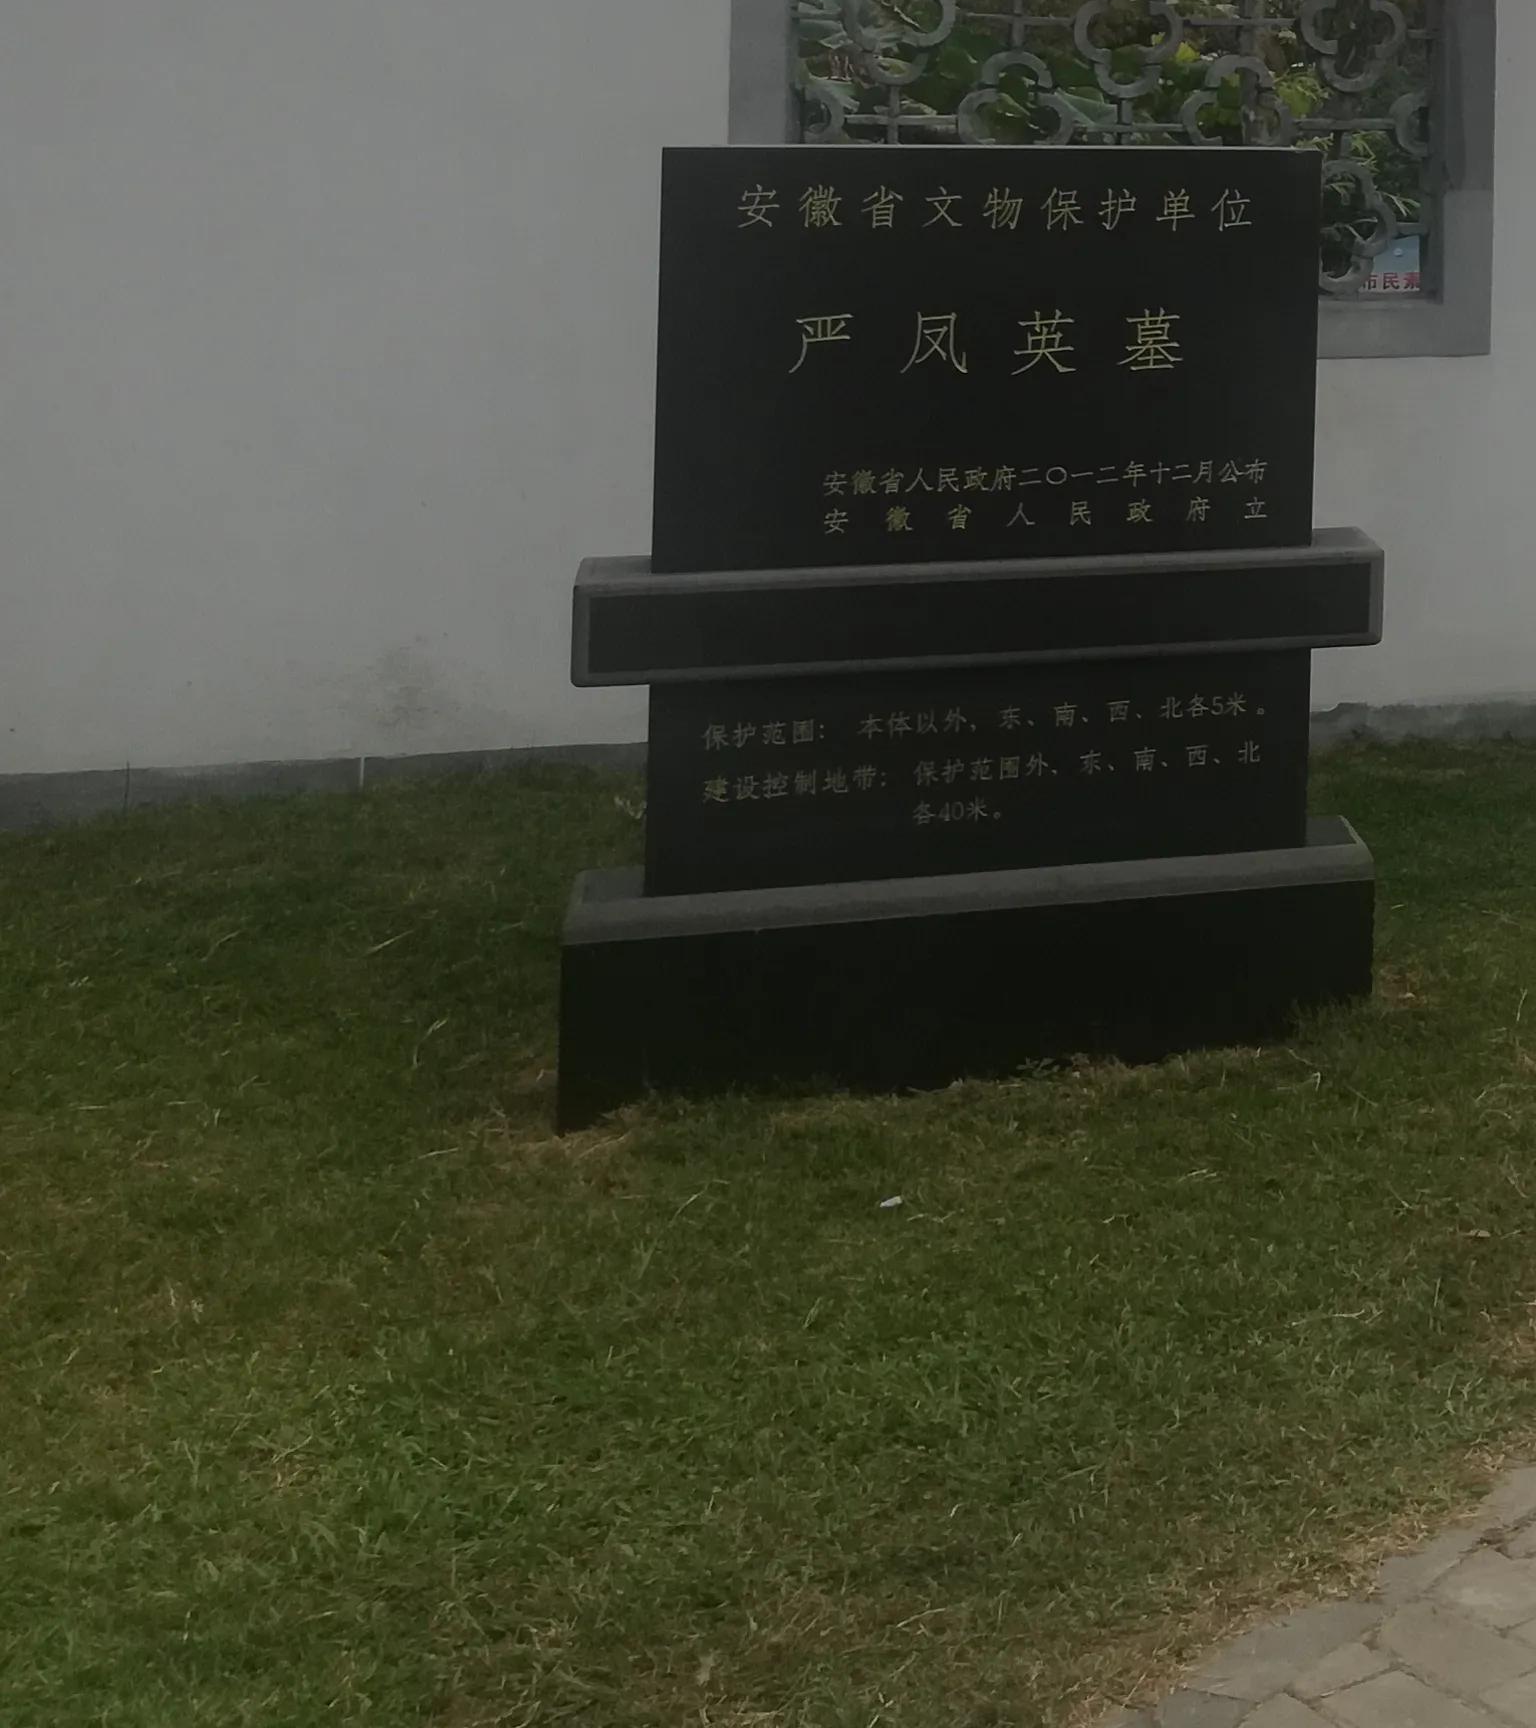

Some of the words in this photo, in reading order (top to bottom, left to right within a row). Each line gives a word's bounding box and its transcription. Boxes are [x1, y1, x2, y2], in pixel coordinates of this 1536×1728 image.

[737, 184, 1255, 229] 安徽省文物保护单位
[789, 309, 1184, 375] 严凤英墓
[823, 497, 1268, 535] 安徽省人民政府立
[912, 799, 1004, 826] 各40米。
